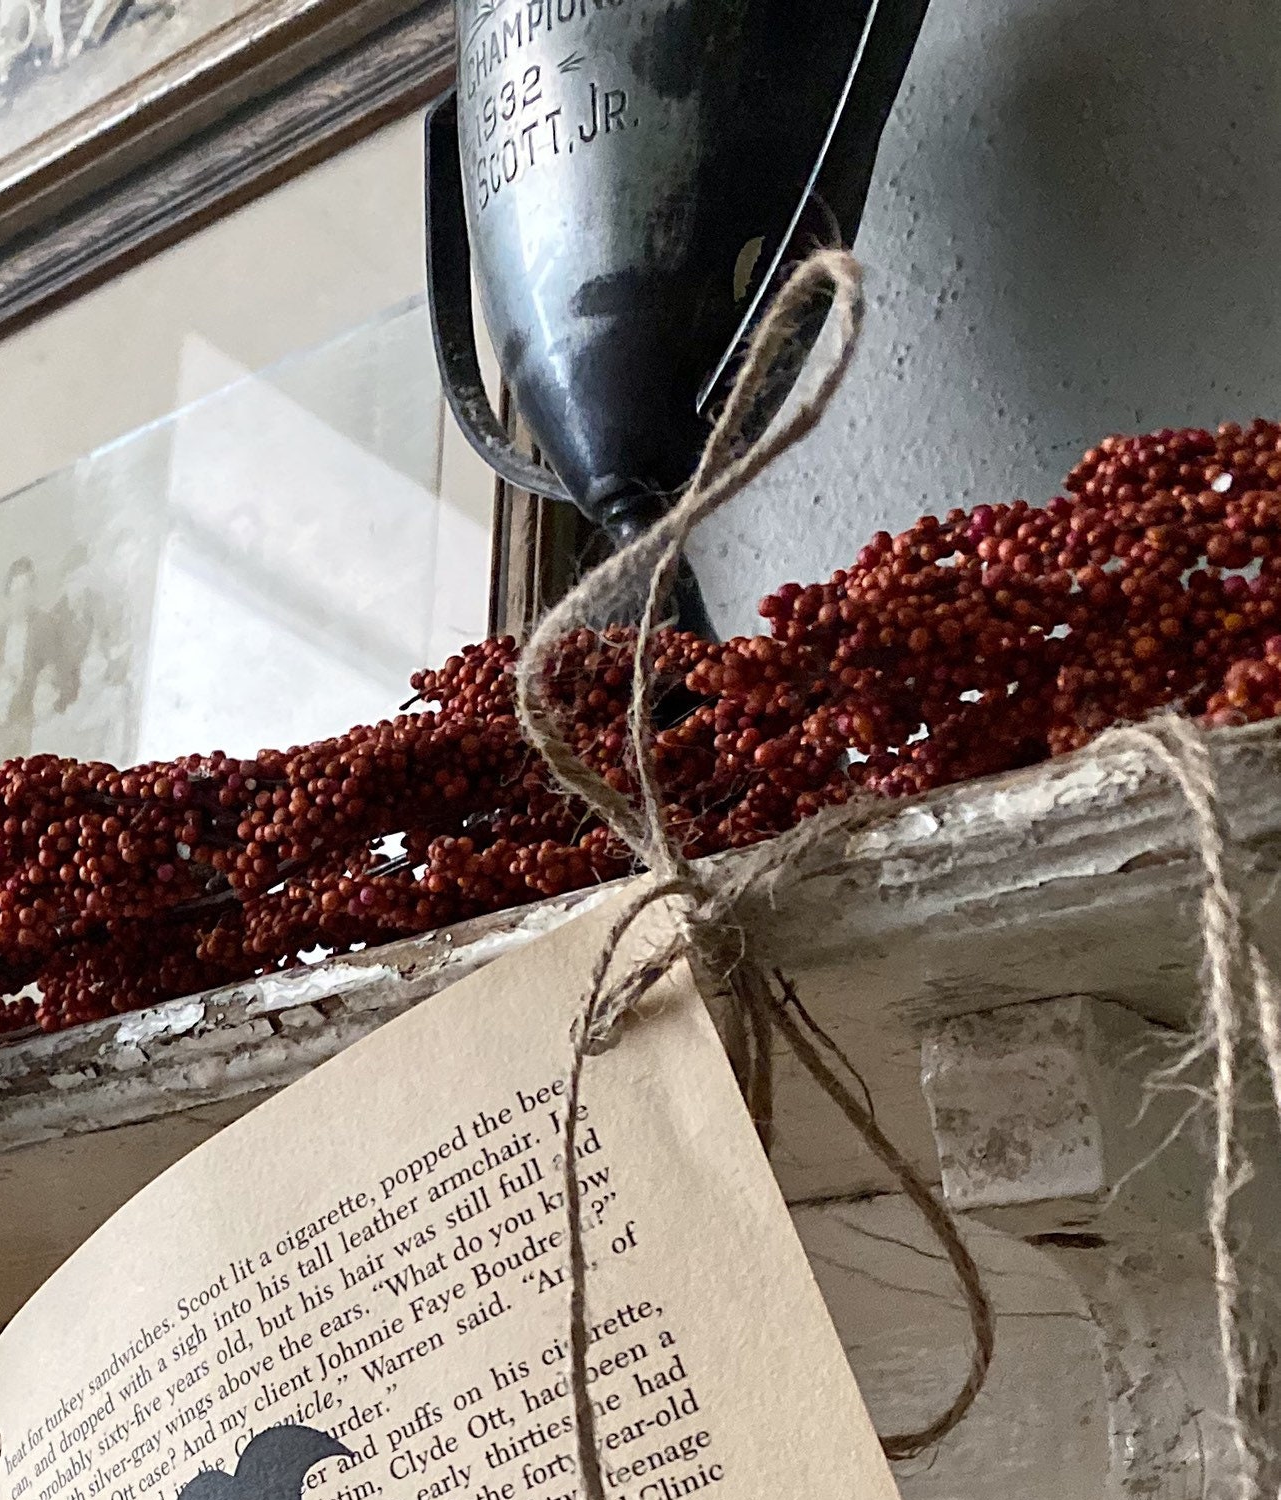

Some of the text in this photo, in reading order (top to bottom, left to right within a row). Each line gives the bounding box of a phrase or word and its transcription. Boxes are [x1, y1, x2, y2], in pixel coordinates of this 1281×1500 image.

[467, 0, 622, 100] CHAMPIO
[476, 65, 542, 148] 1932
[578, 82, 640, 144] JR.
[88, 1107, 513, 1395] sandwiches. Scoot lit a cigarette, popped the
[212, 1132, 540, 1331] into his tall leather armchair.
[278, 1332, 313, 1361] the
[319, 1303, 370, 1338] ears.
[452, 1234, 483, 1261] do
[487, 1207, 535, 1248] you
[360, 1290, 511, 1383] Warren said.
